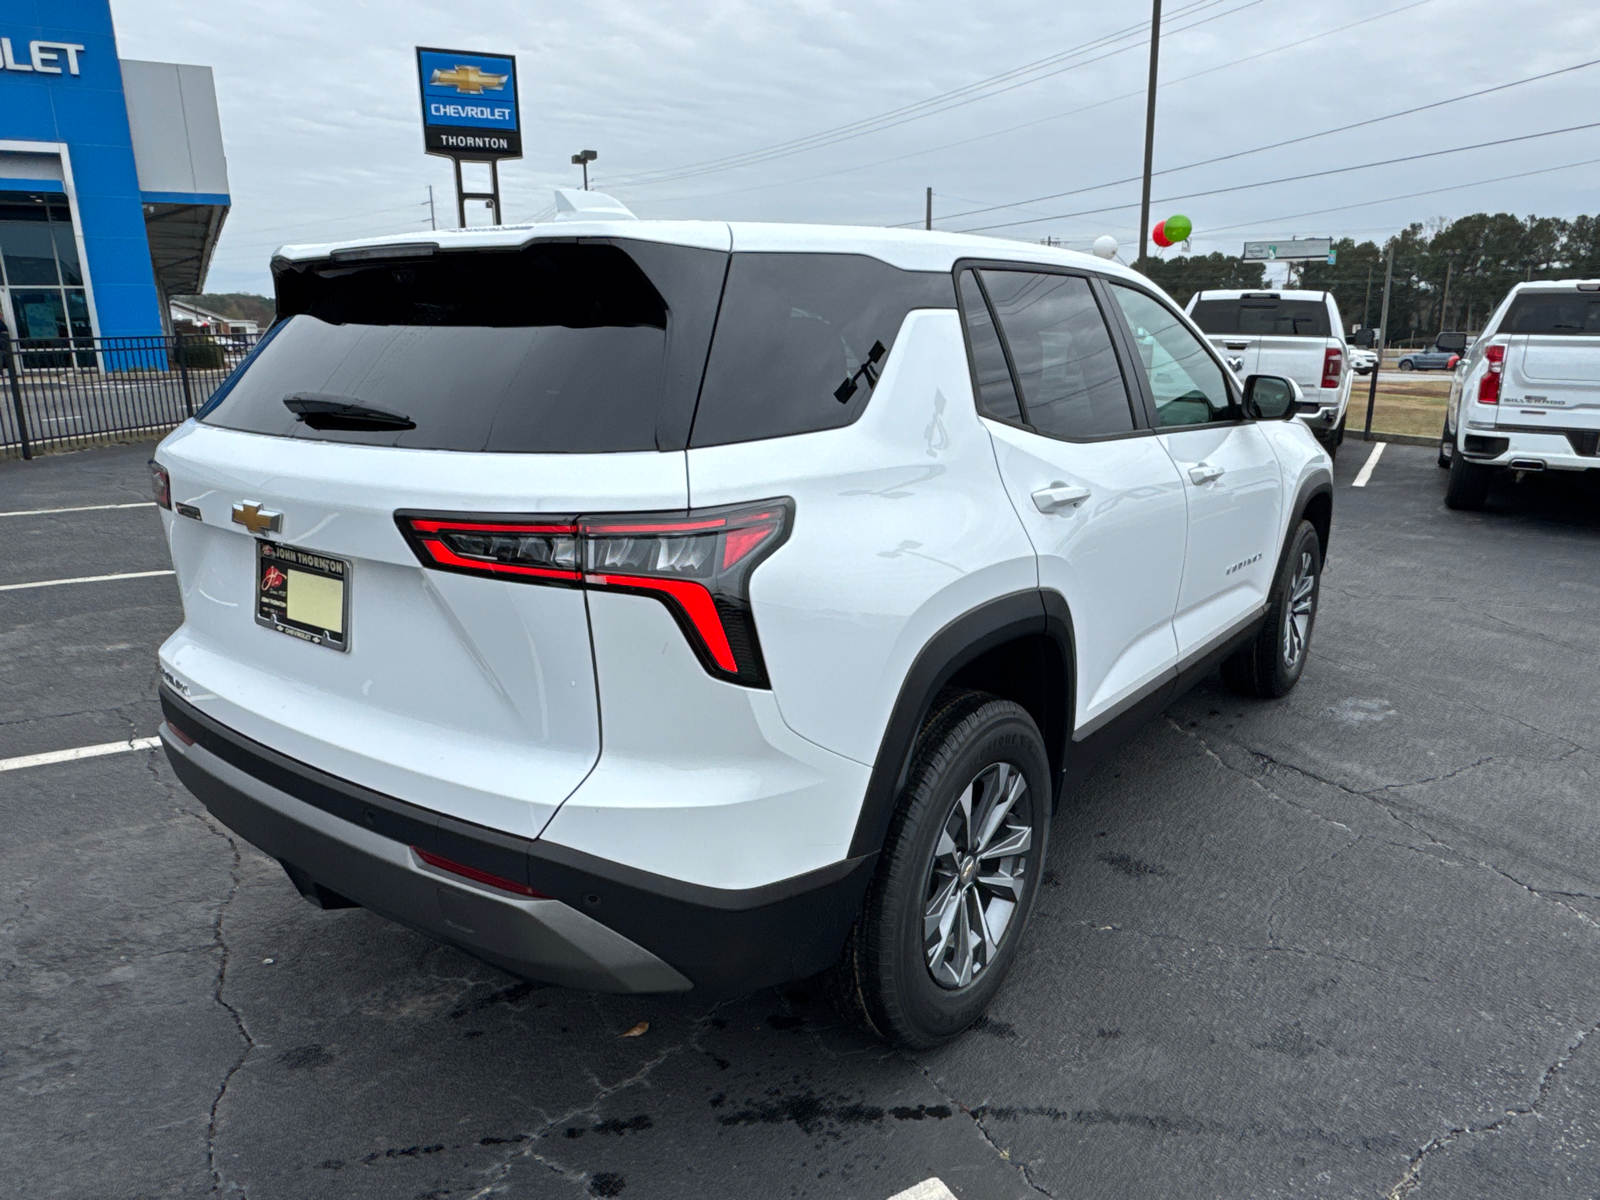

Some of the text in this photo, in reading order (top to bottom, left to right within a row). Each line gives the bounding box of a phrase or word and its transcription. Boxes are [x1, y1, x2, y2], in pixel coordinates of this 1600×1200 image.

[0, 37, 85, 76] LET
[431, 103, 511, 120] CHEVROLET
[440, 134, 508, 149] THORNTON
[276, 547, 342, 573] JOHN THORNTON
